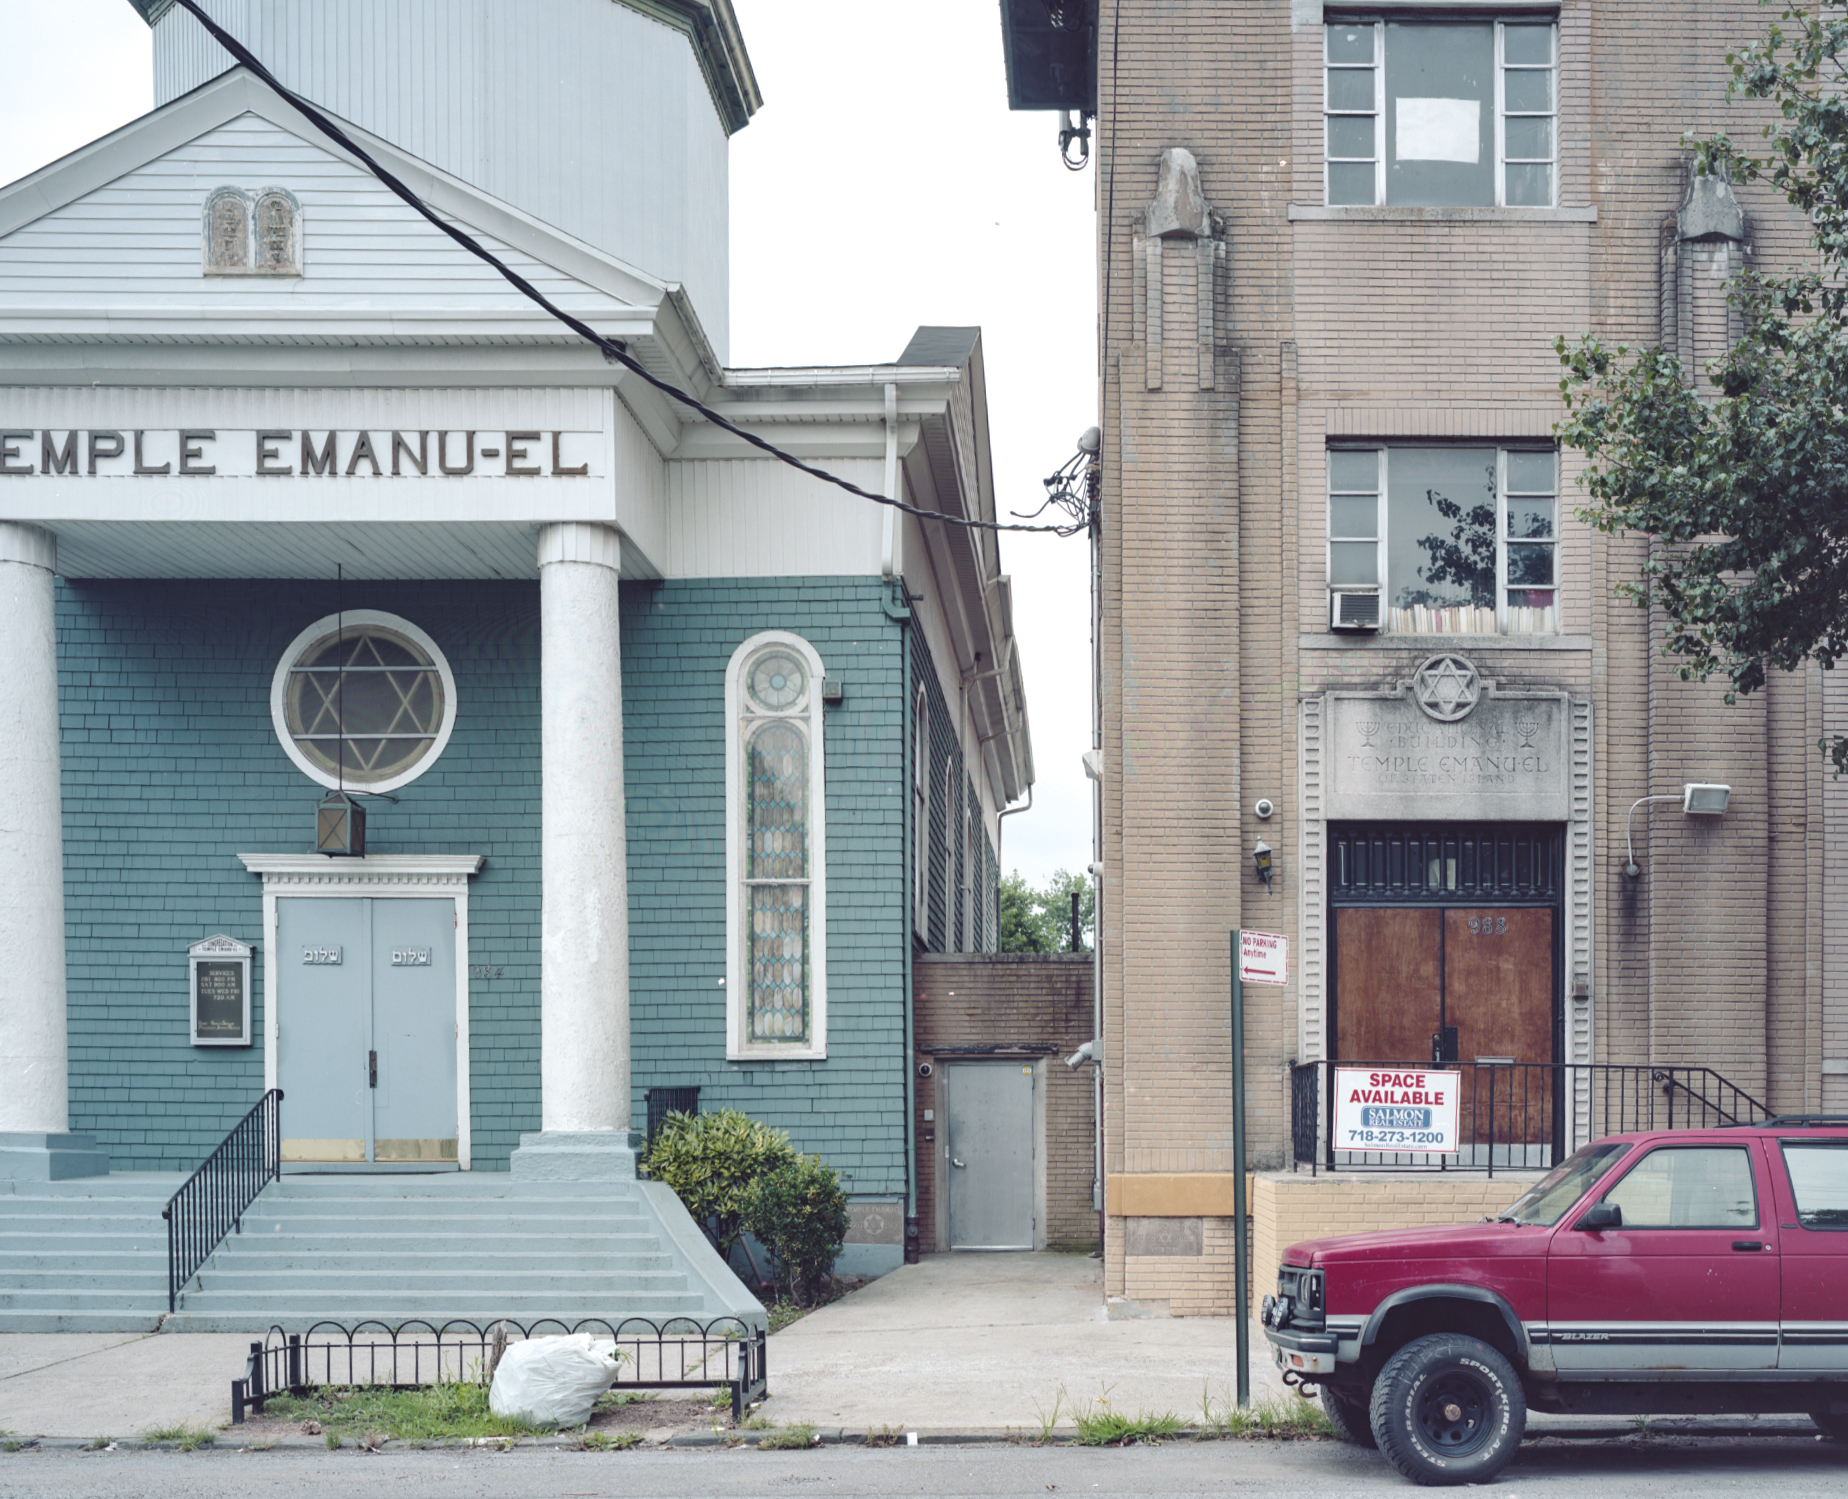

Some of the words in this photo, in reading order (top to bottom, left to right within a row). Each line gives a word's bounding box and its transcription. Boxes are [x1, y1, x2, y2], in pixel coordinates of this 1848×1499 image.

[256, 430, 588, 475] EMANU-EL
[1387, 722, 1509, 735] EDUCATIONAL
[1398, 736, 1499, 748] BUILDING
[1348, 756, 1428, 772] TEMPLE
[1378, 774, 1395, 784] OF
[1402, 774, 1456, 784] STATEN
[1463, 774, 1516, 784] ISLAND
[1469, 916, 1506, 935] 988
[1243, 937, 1251, 946] NO
[1253, 938, 1277, 949] PARKING
[304, 946, 339, 963] שלום
[392, 947, 428, 964] שלום
[1244, 948, 1267, 959] Anytime
[472, 965, 504, 979] 984
[1369, 1072, 1426, 1089] SPACE
[1349, 1089, 1445, 1106] AVAILABLE
[1368, 1108, 1424, 1120] SALMON
[1348, 1130, 1444, 1144] 718-273-1200
[1562, 1332, 1610, 1341] BLAZER
[1405, 1374, 1427, 1431] RADIAL
[1410, 1434, 1446, 1468] STEEL
